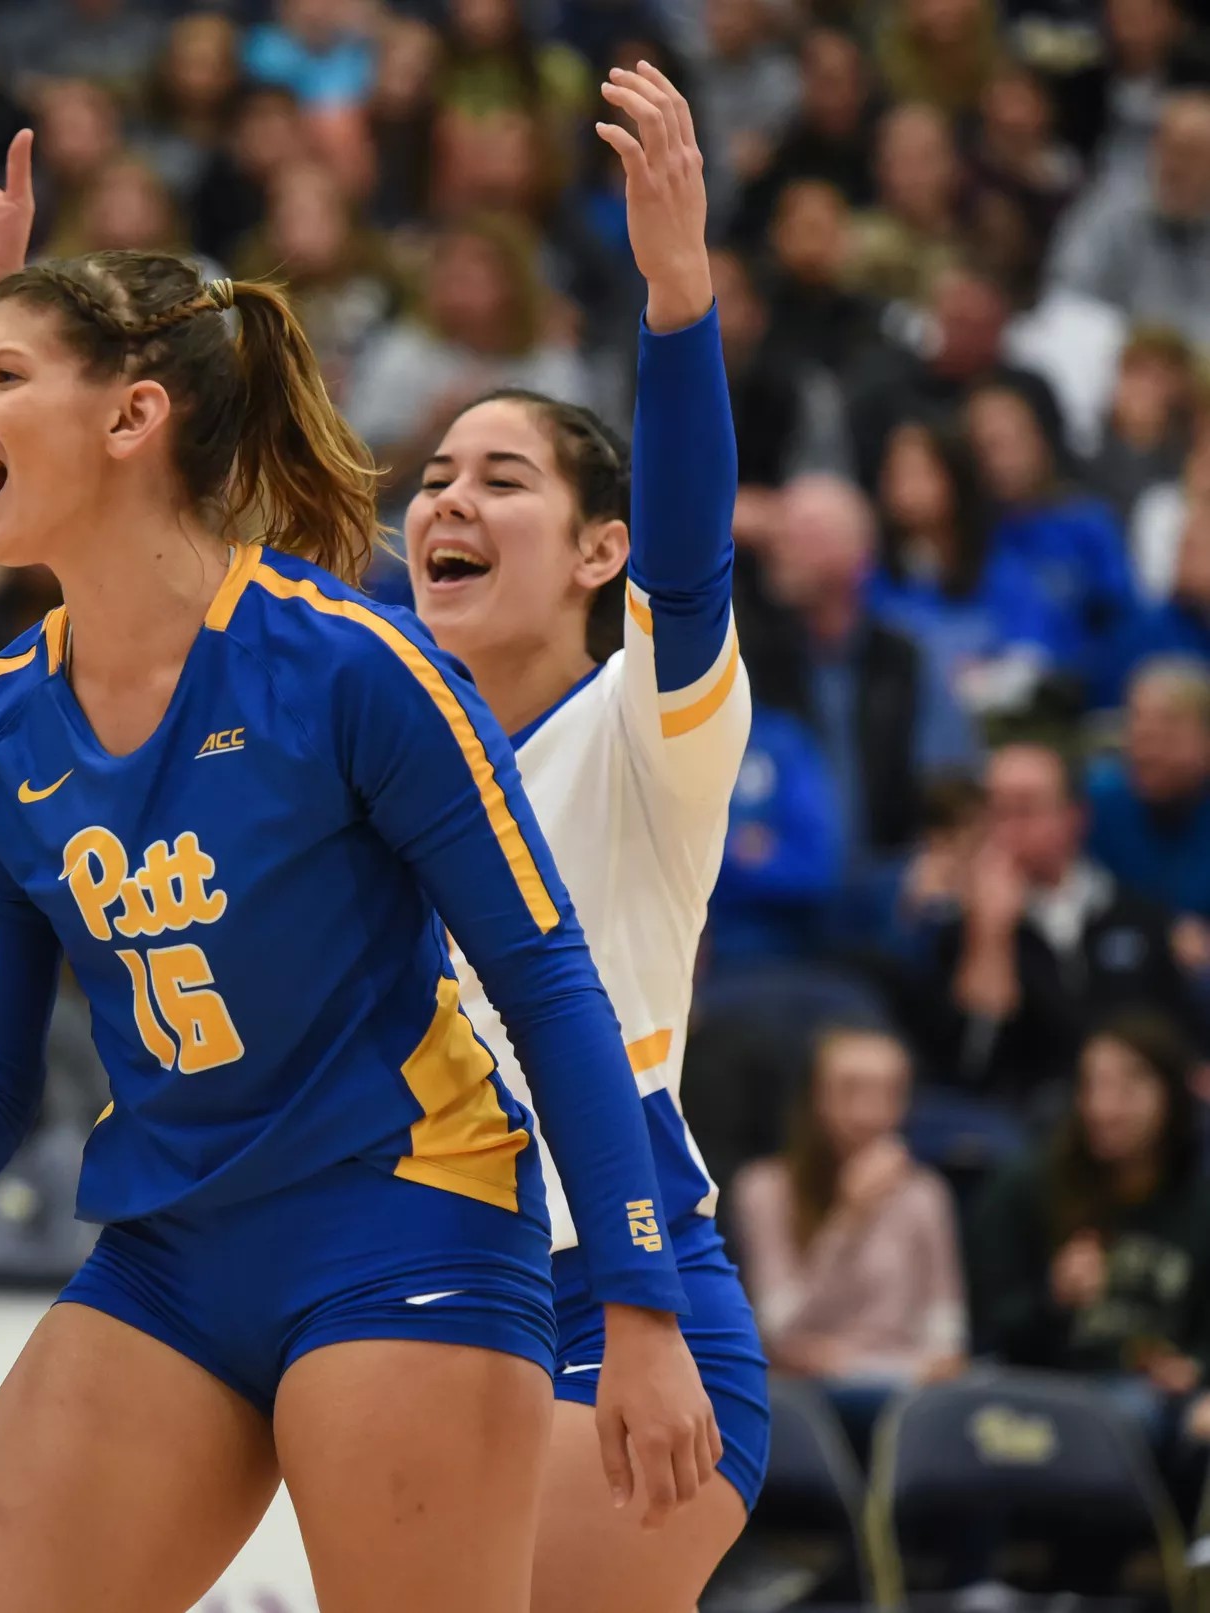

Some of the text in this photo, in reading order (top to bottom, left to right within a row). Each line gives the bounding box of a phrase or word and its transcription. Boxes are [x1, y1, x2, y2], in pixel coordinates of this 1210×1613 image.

[198, 726, 246, 754] ACC
[58, 825, 228, 942] Pitt
[114, 943, 245, 1075] 16
[625, 1198, 663, 1253] H2P
